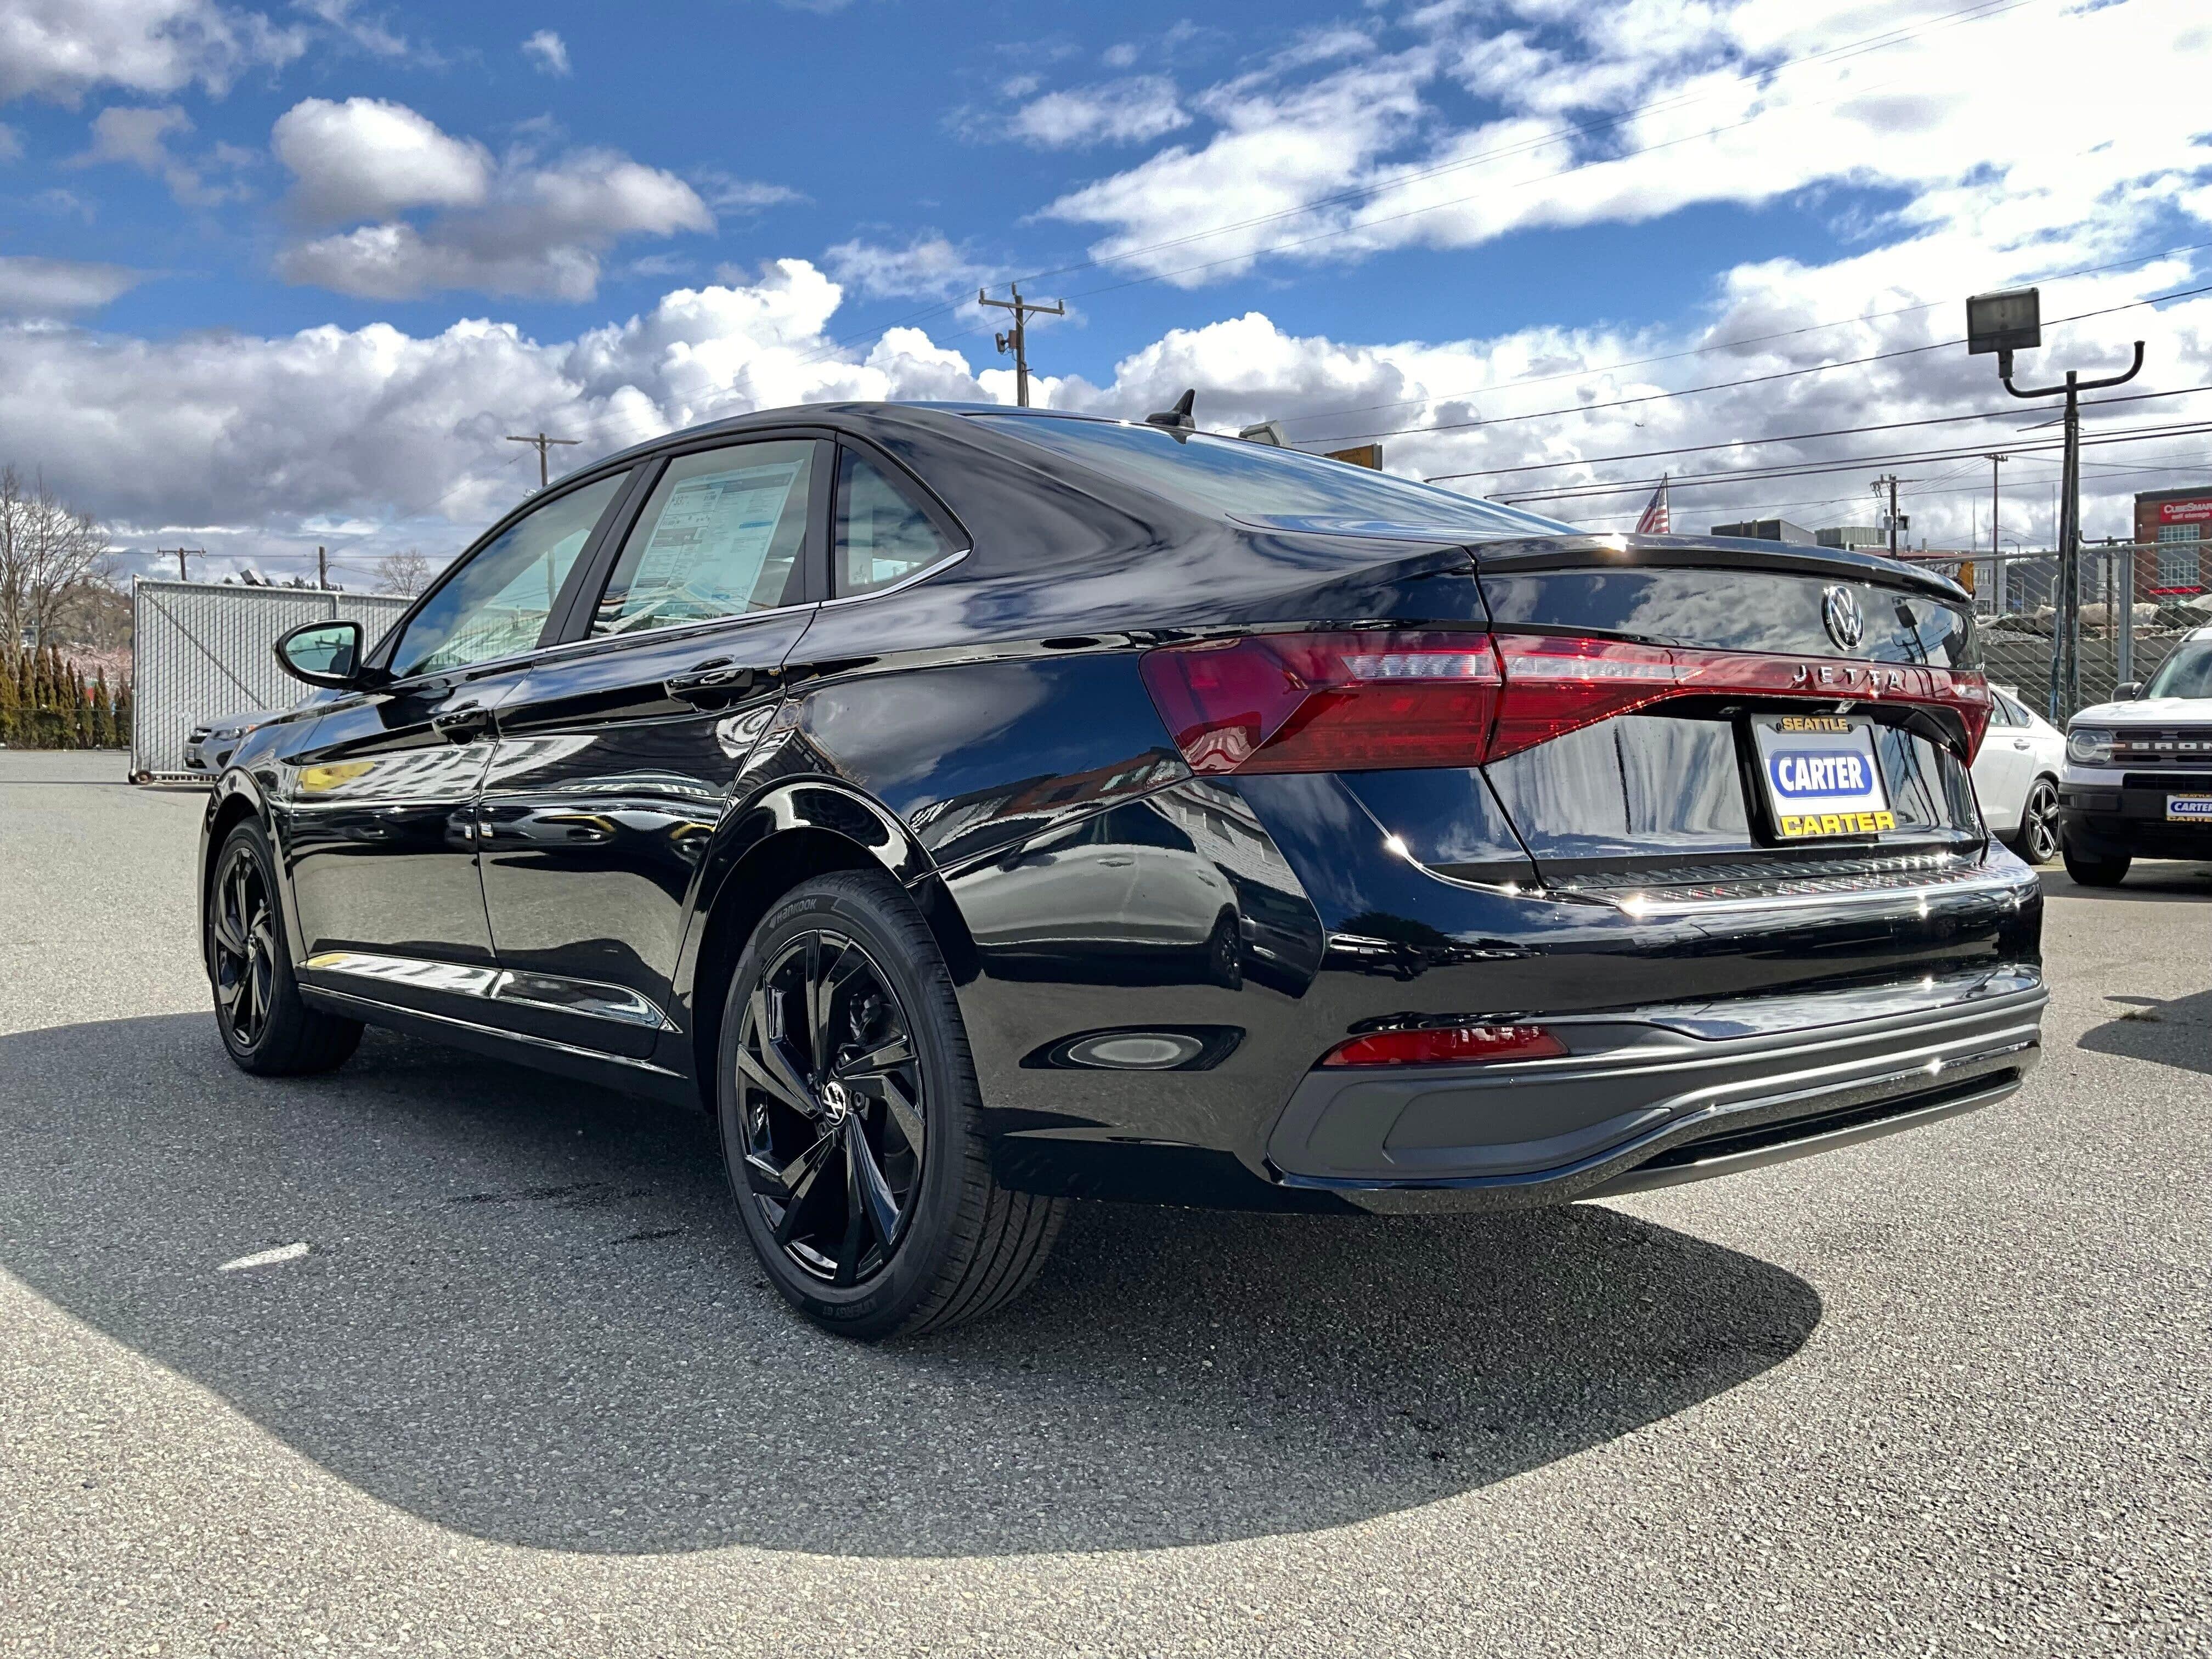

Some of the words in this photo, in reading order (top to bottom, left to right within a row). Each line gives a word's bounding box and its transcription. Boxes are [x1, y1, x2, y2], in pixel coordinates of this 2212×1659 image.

[1793, 665, 1900, 688] JETTA
[1781, 717, 1848, 731] SEATTLE
[1779, 757, 1865, 791] CARTER
[1781, 811, 1895, 836] CARTER
